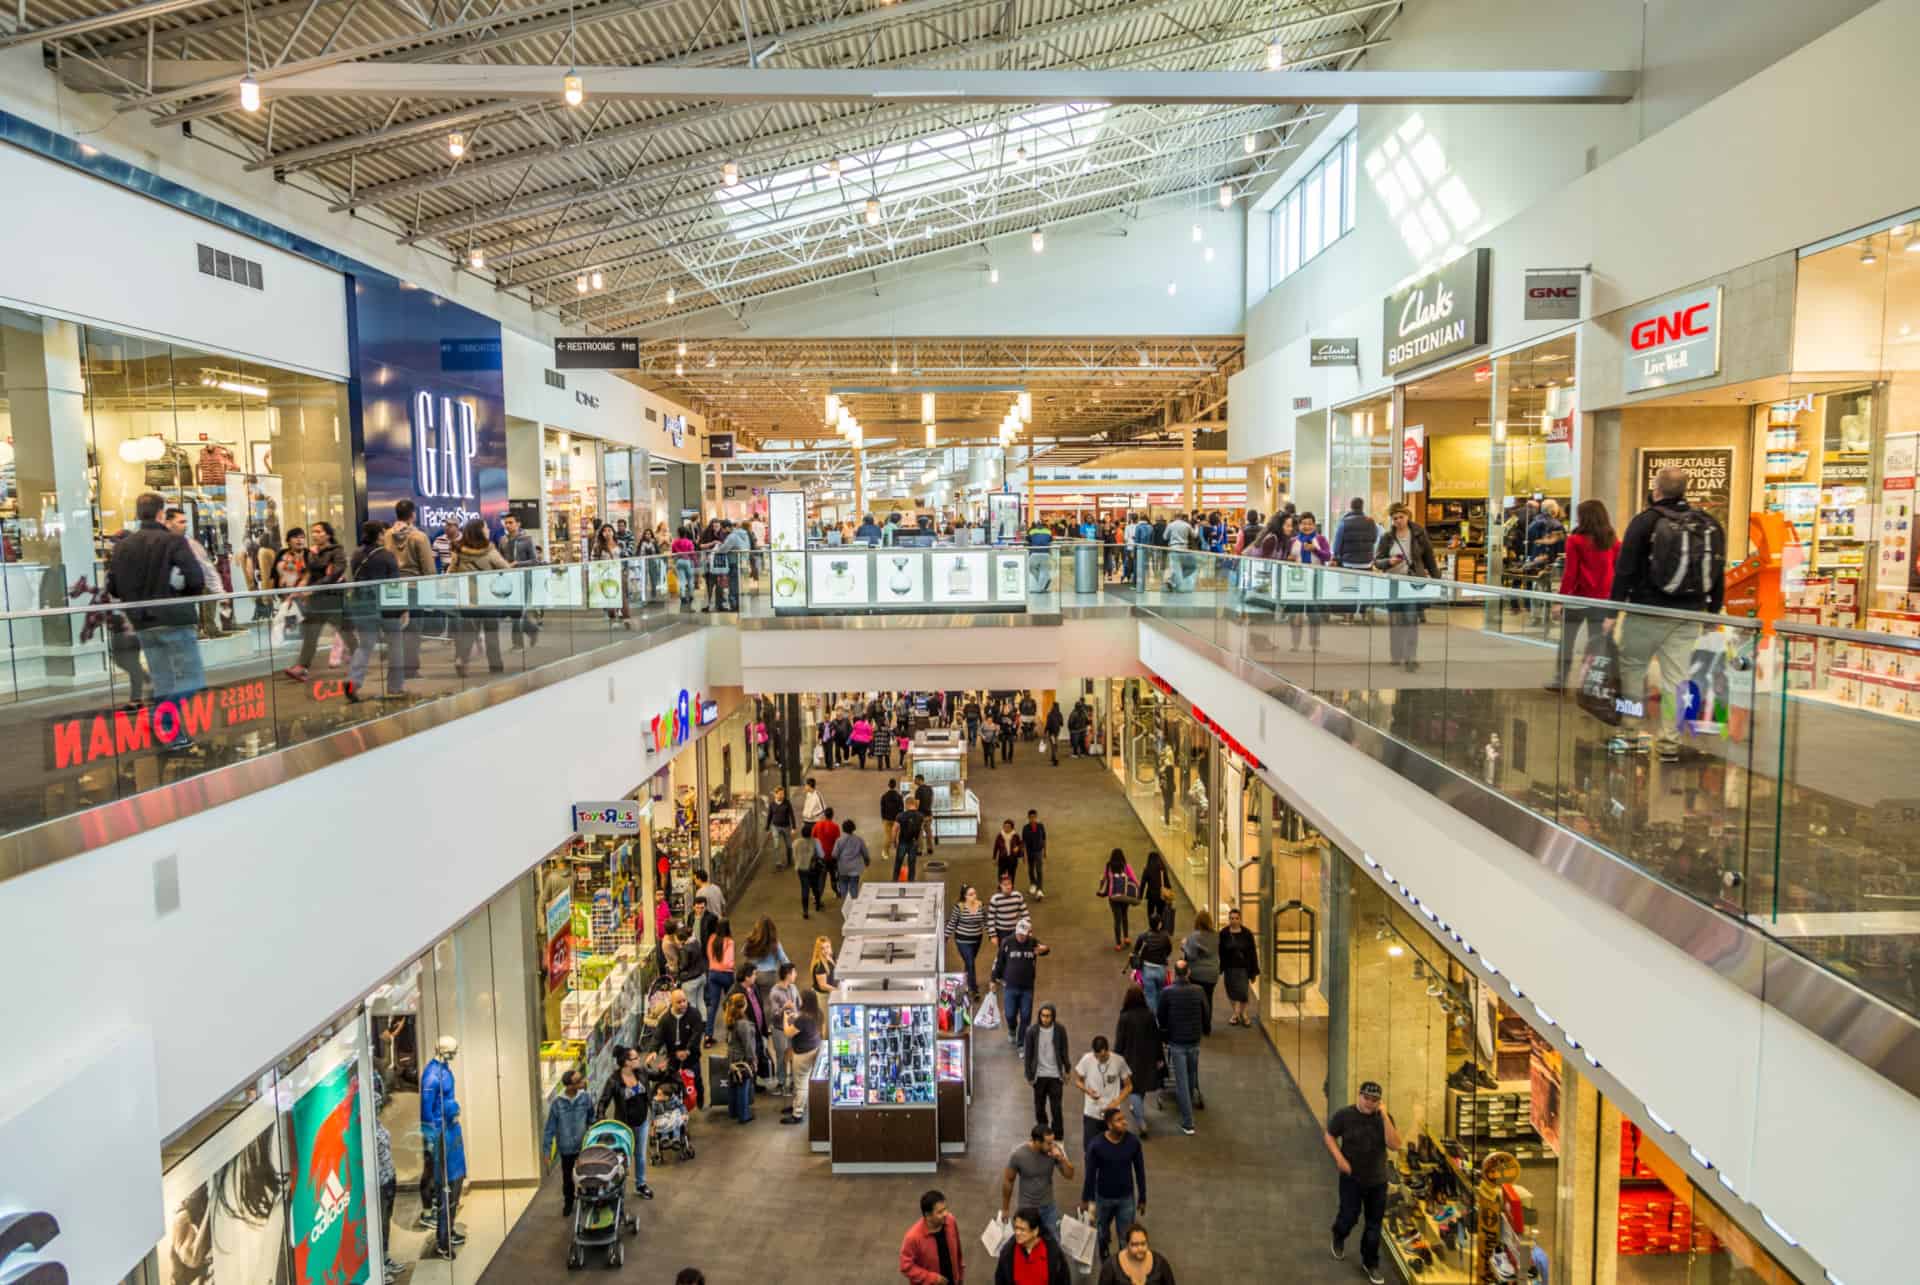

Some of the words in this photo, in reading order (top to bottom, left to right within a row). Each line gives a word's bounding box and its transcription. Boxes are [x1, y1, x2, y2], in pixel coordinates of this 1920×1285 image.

[1399, 280, 1454, 337] Clarks
[1528, 287, 1577, 299] GNC
[567, 342, 616, 351] RESTROOMS
[1388, 320, 1465, 367] BOSTONIAN
[1630, 302, 1710, 351] GNC
[414, 391, 477, 499] GAP
[1649, 457, 1728, 469] UNBEATABLE
[1697, 478, 1726, 489] DAY
[311, 1191, 351, 1243] adidas
